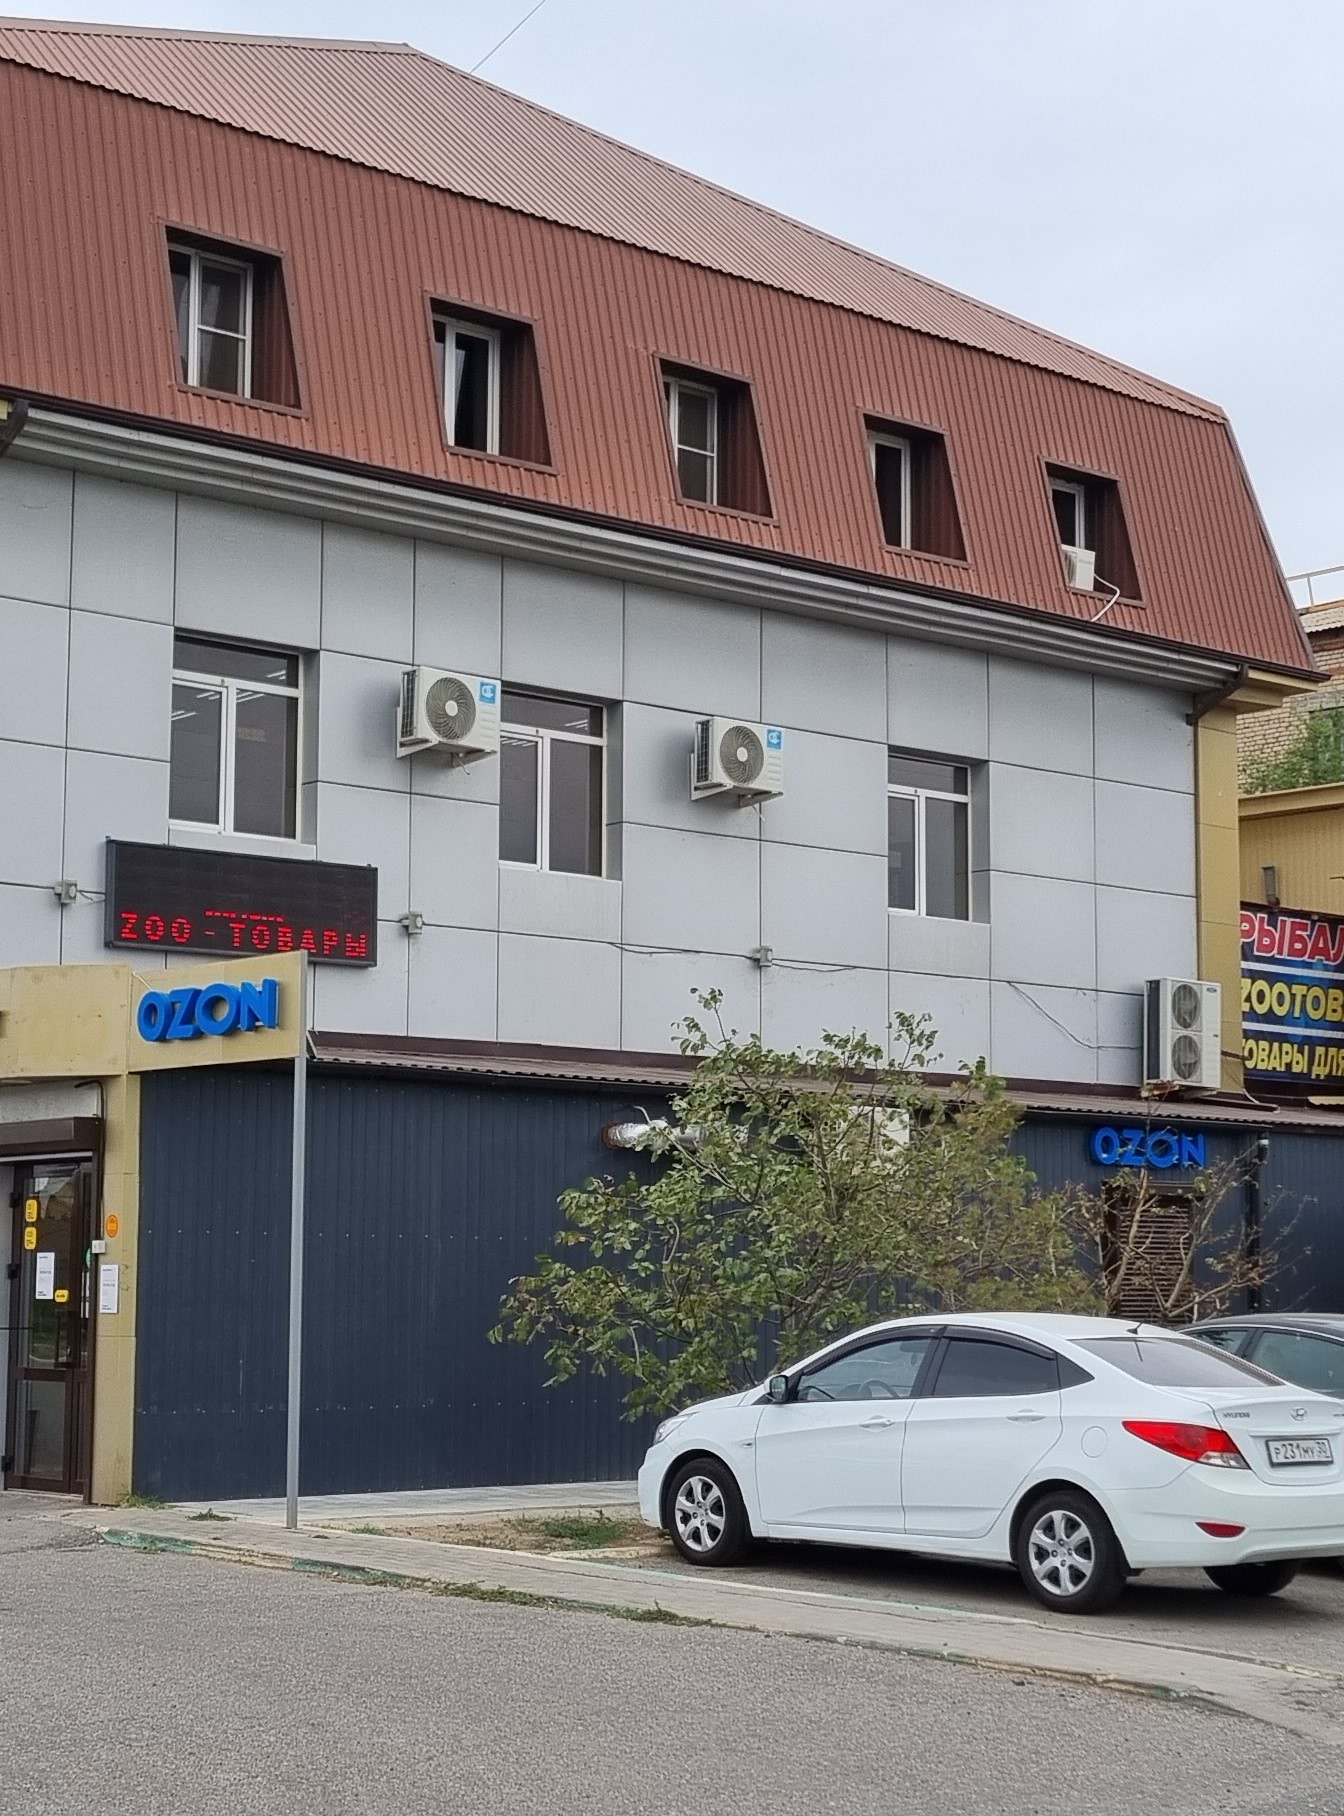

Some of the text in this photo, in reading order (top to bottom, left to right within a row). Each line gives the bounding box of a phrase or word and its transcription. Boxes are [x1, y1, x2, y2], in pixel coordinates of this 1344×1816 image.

[136, 977, 279, 1043] OZON
[1241, 1038, 1309, 1074] ОВАРЫ
[1092, 1126, 1205, 1168] OZON
